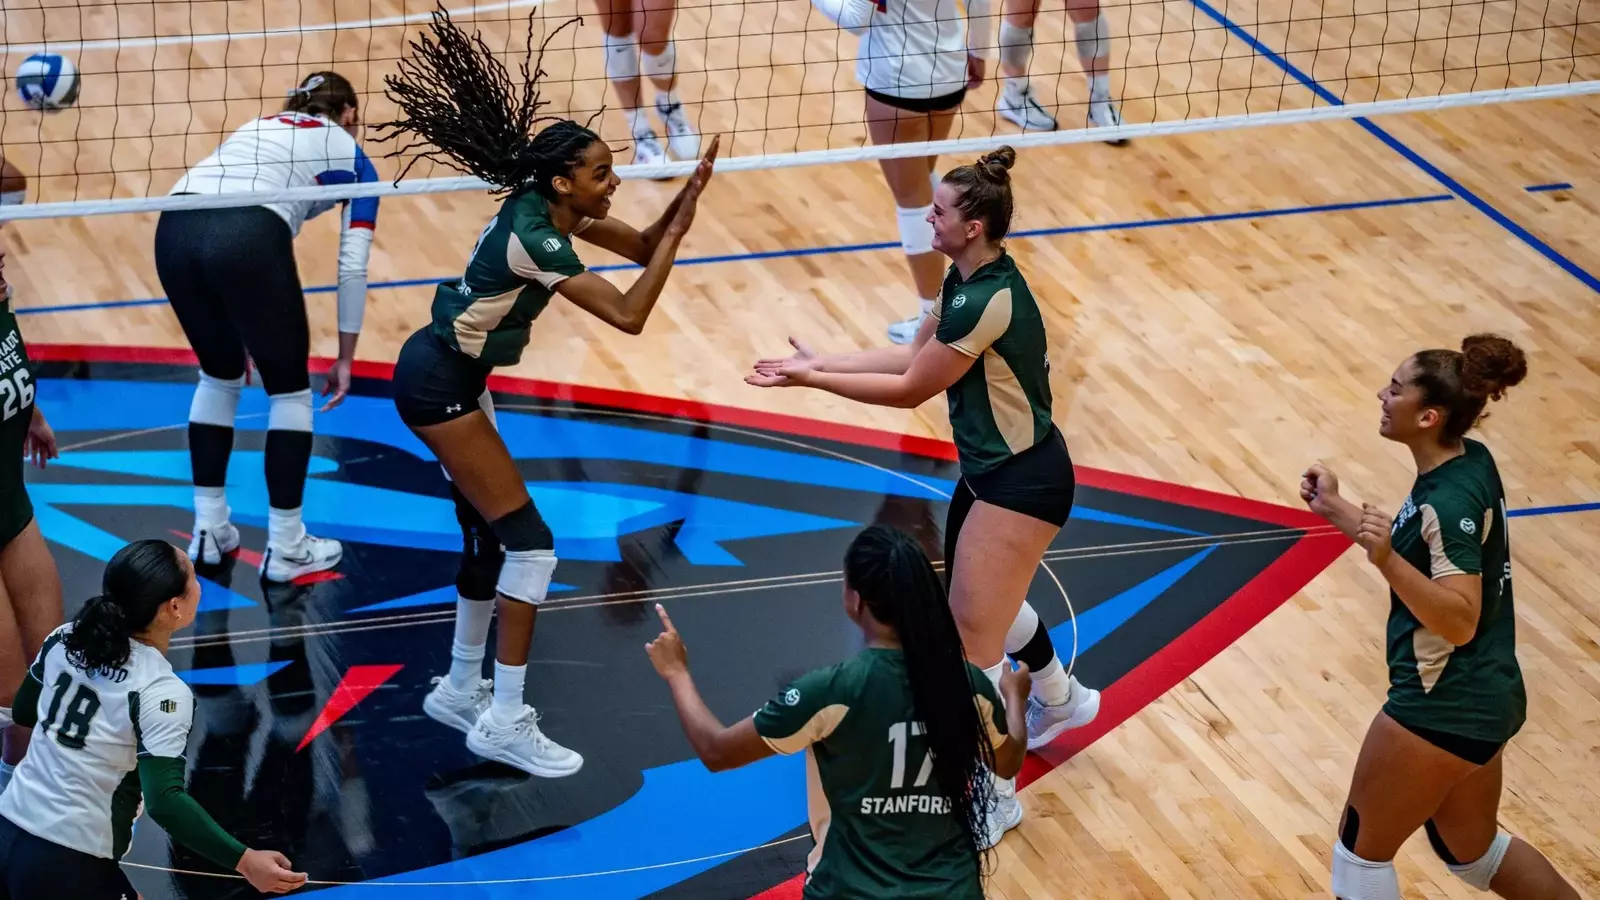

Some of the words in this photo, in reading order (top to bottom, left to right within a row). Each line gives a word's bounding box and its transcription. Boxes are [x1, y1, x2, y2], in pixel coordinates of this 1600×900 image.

[0, 351, 22, 376] ATE
[0, 367, 35, 421] 26
[41, 671, 102, 750] 18
[888, 721, 936, 789] 17
